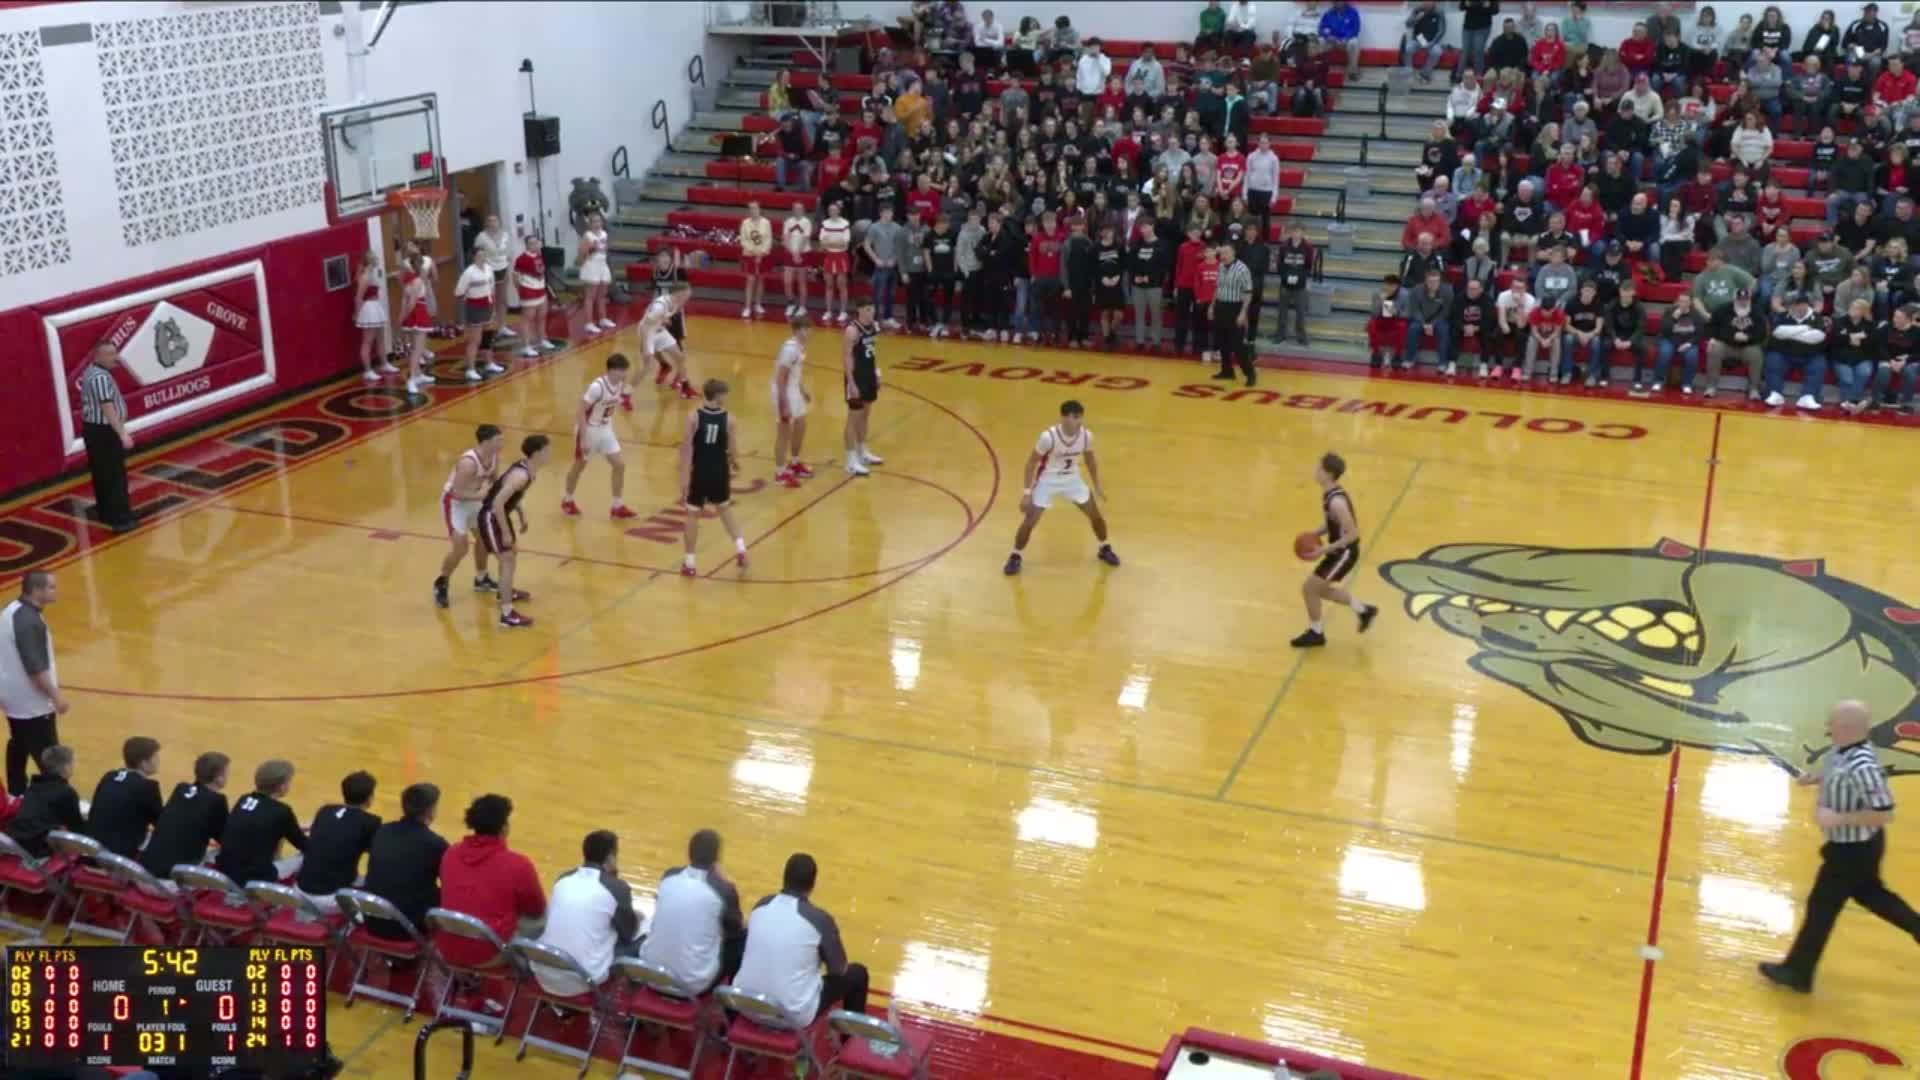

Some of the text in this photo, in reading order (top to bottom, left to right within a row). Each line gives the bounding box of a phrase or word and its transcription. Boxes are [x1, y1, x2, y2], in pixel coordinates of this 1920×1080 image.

[206, 301, 248, 331] GROVE
[143, 375, 212, 409] BULLDOGS
[892, 355, 1648, 441] COLUMBUS GROVE
[705, 423, 719, 444] 11
